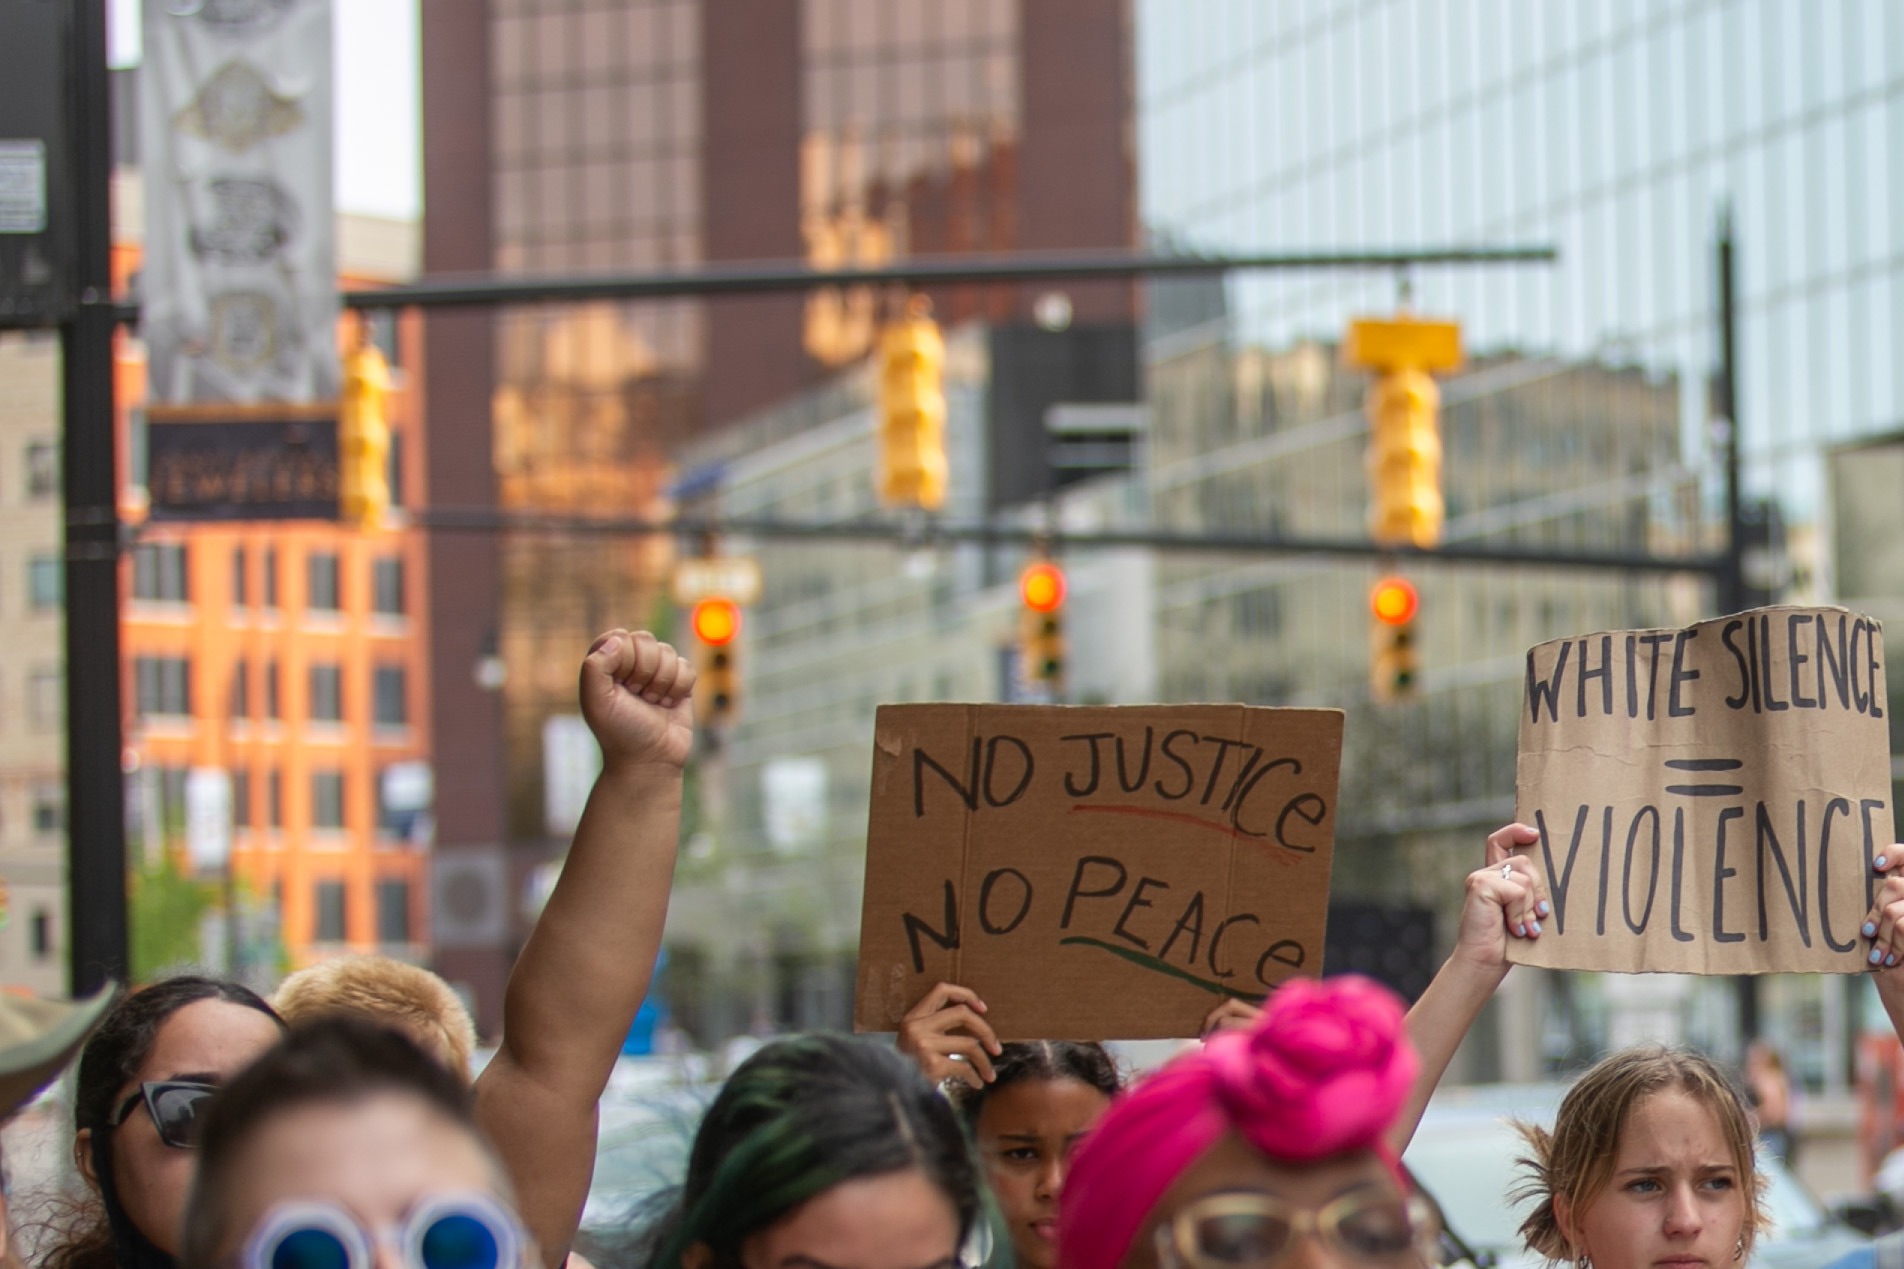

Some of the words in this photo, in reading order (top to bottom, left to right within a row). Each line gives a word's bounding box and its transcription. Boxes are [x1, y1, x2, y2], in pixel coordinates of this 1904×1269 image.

[1526, 630, 1701, 724] WHITE
[1721, 613, 1884, 718] SILENCE
[914, 734, 1035, 818] NO
[902, 867, 1034, 974] NO
[1535, 798, 1886, 954] VIOLENCE
